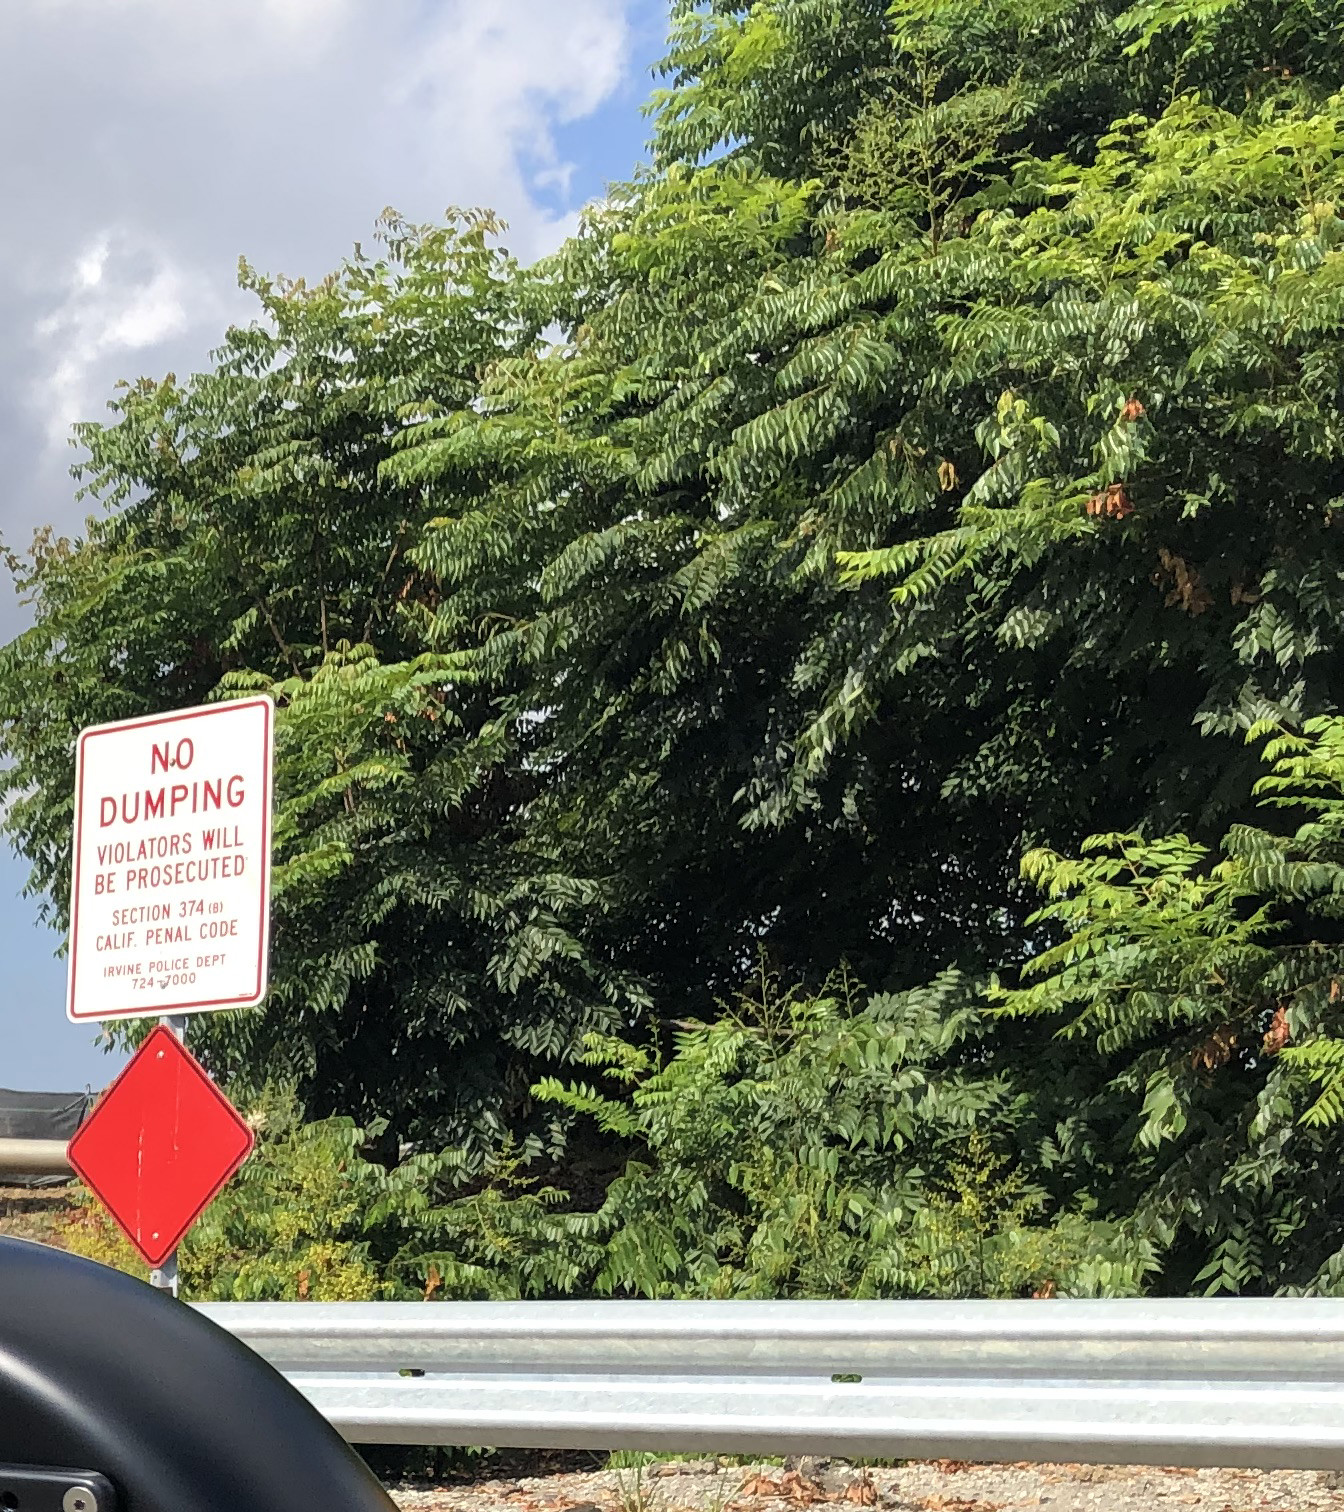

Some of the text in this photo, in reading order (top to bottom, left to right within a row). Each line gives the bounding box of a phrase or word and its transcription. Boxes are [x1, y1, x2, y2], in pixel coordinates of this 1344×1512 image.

[151, 738, 194, 774] NO
[100, 775, 245, 828] DUMPING
[97, 826, 244, 866] VIOLATORS WILL
[95, 855, 245, 895] BE PROSECUTED
[113, 903, 171, 927] SECTION
[179, 898, 204, 918] 374
[96, 919, 238, 951] CALIF. PENAL CODE
[104, 954, 226, 978] IRVINE POLICE DEPT
